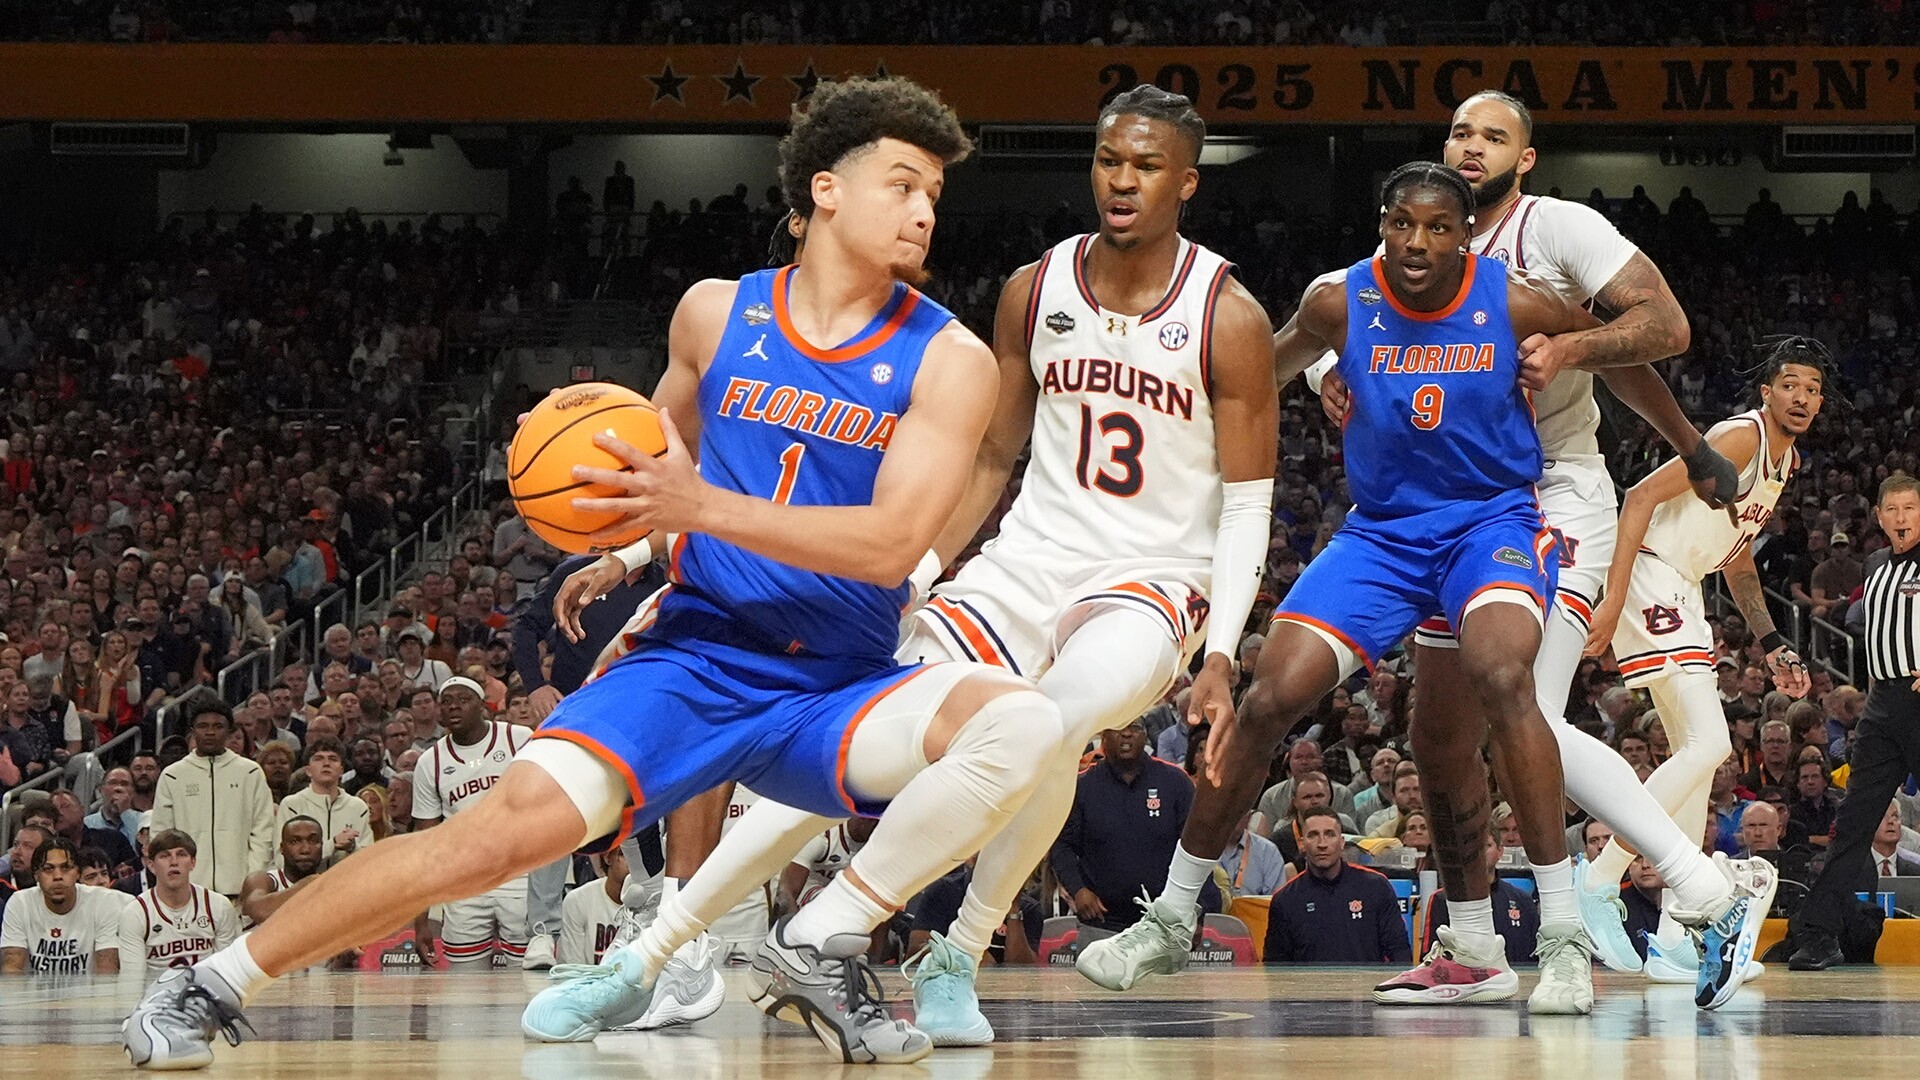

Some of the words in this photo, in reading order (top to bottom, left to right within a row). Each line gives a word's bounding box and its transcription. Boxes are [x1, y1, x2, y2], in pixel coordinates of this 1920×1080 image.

[1099, 63, 1315, 111] 2025
[1361, 59, 1619, 112] NCAA
[1661, 59, 1920, 112] MEN'
[1160, 323, 1188, 350] SEC
[871, 363, 892, 383] SEC
[1368, 343, 1495, 374] FLORIDA
[1043, 358, 1193, 422] AUBURN
[717, 376, 898, 452] FLORIDA
[1410, 383, 1445, 431] 9
[1075, 401, 1145, 498] 13
[771, 442, 806, 506] 1
[36, 938, 78, 957] MAKE
[382, 953, 405, 964] FINAL
[1050, 953, 1075, 964] FINAL
[1208, 951, 1233, 962] FOUR
